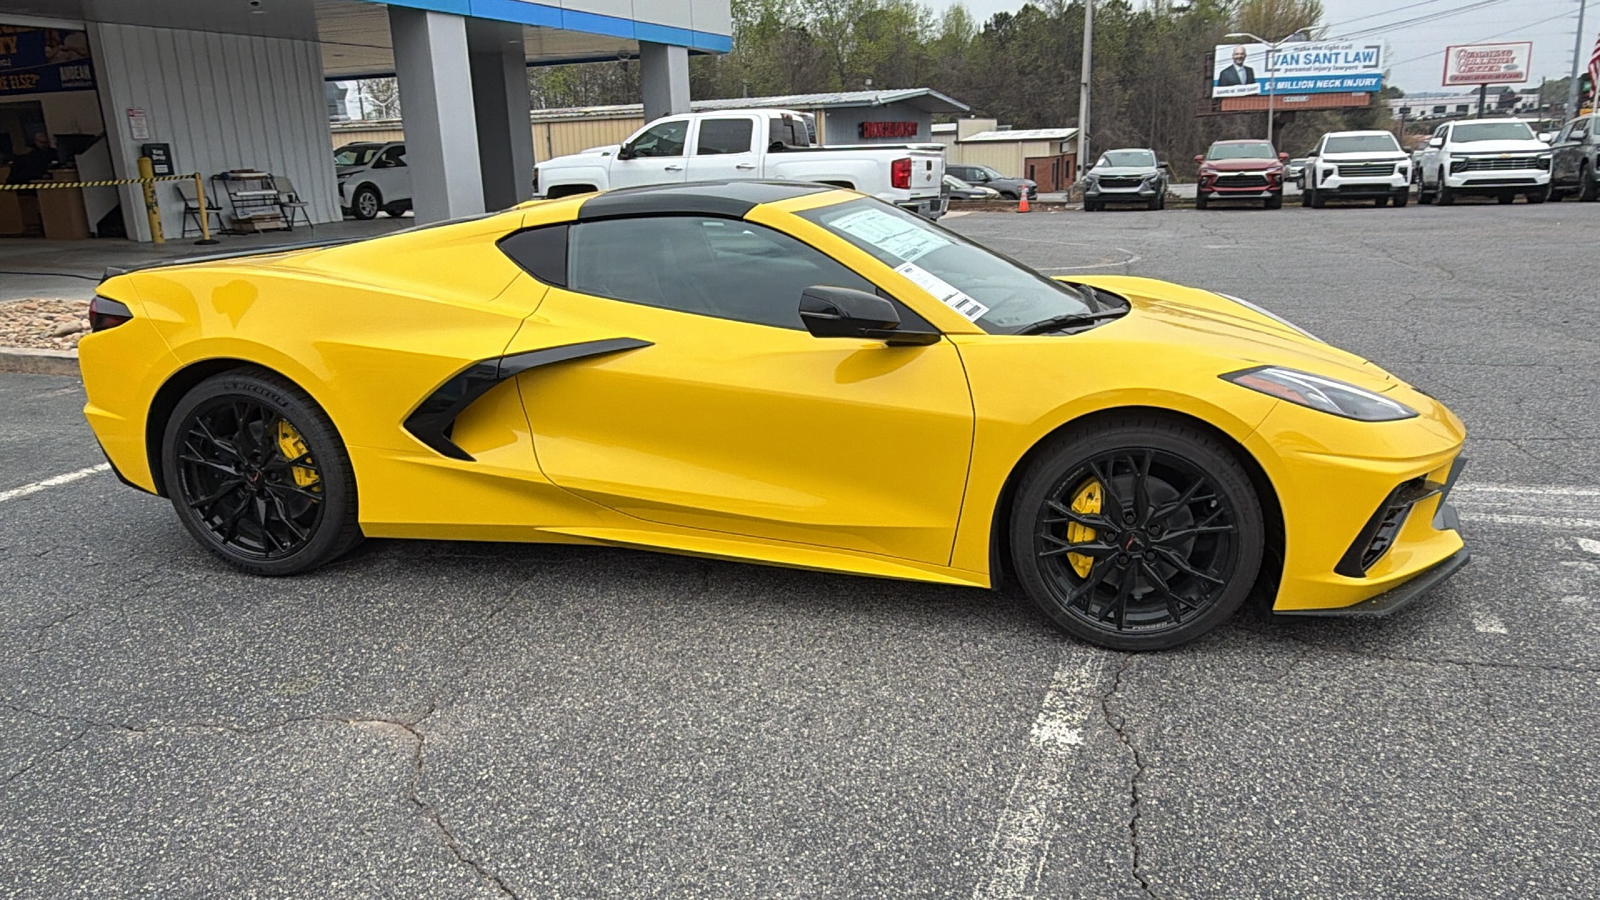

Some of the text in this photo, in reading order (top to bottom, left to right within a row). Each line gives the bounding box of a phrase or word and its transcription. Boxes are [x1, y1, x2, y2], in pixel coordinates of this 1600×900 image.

[1324, 44, 1340, 52] right
[1273, 51, 1374, 66] VAN SANT LAW
[1284, 66, 1312, 74] personal
[1276, 80, 1314, 91] MILLION
[1316, 79, 1342, 88] NECK
[1343, 77, 1378, 87] INJURY
